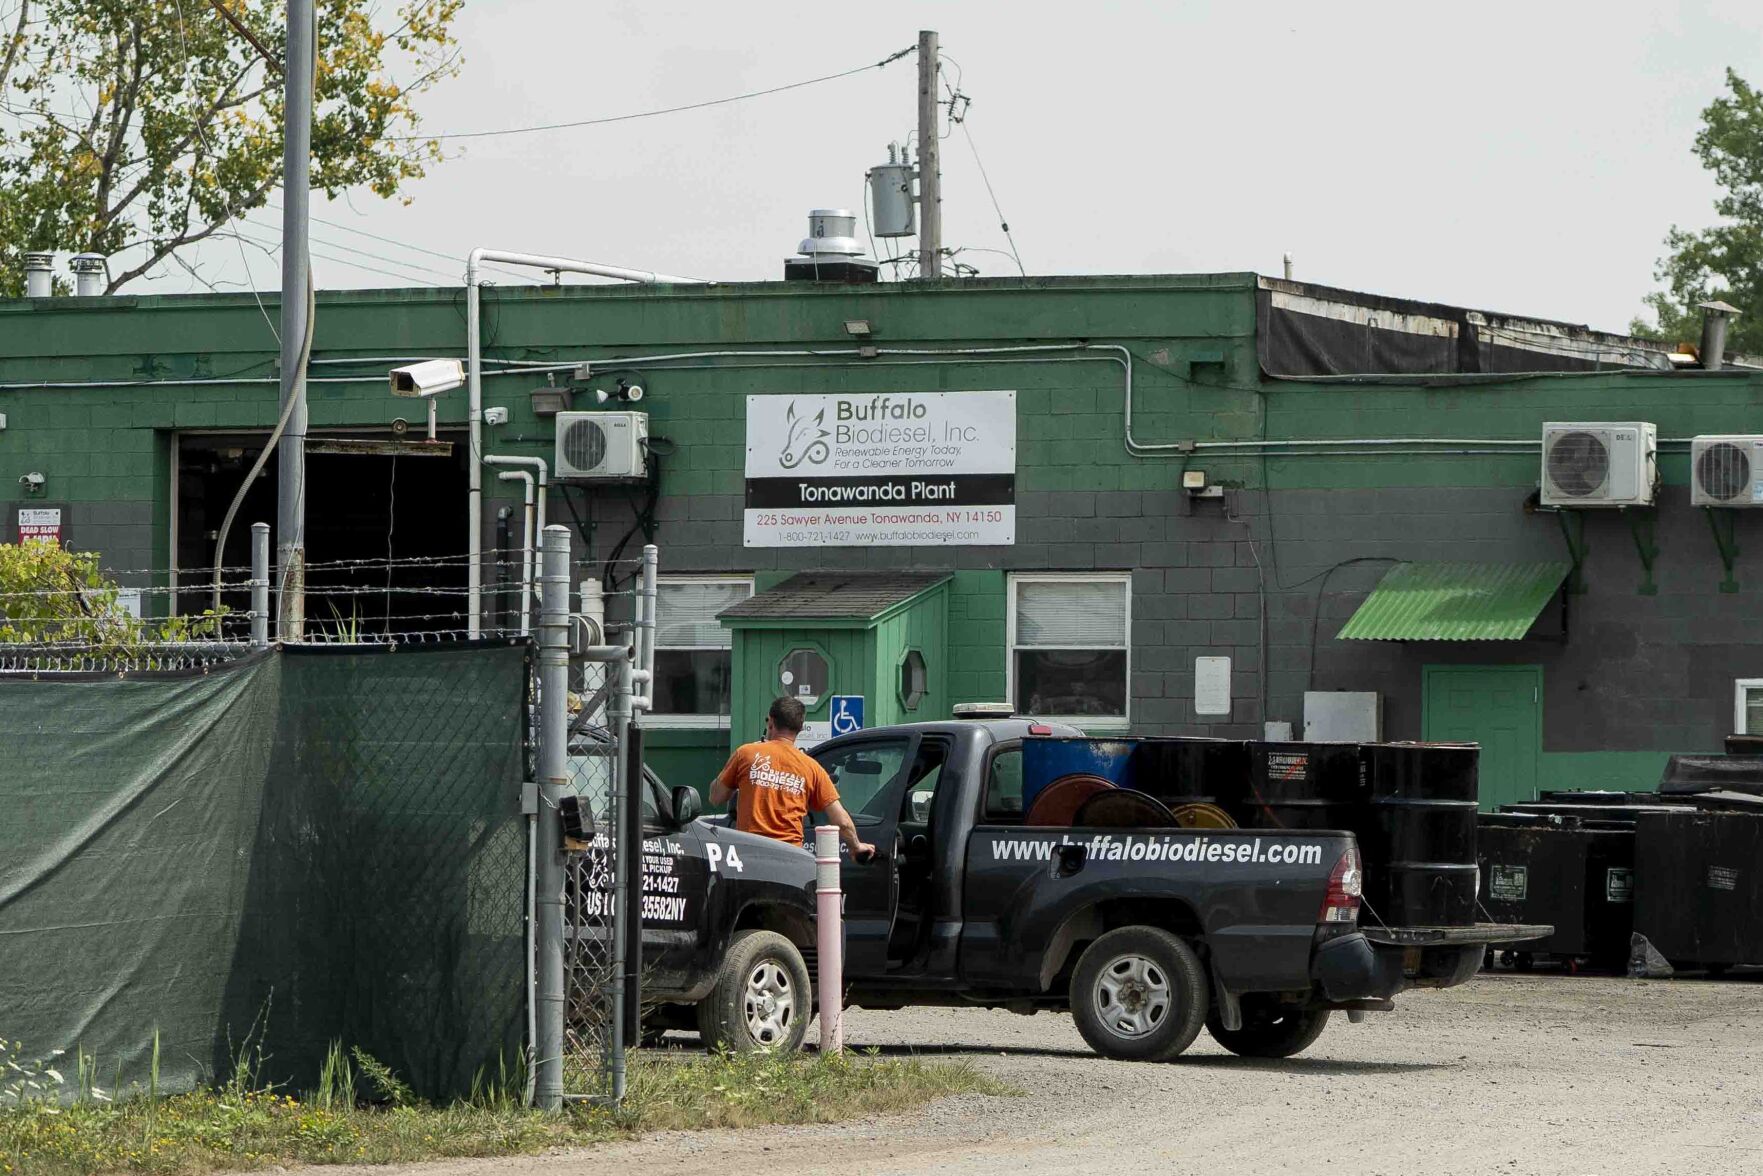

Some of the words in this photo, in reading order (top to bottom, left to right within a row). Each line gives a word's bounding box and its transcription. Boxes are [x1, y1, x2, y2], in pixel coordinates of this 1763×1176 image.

[836, 397, 927, 421] Buffalo
[836, 421, 936, 444] Biodiesel,
[944, 419, 980, 442] Inc.
[835, 446, 891, 458] Renewable
[892, 446, 928, 459] Energy
[834, 459, 852, 469] For
[852, 460, 860, 469] a
[862, 458, 901, 469] Cleaner
[904, 457, 955, 468] Tomorrow
[798, 482, 906, 502] Tonawanda
[911, 481, 956, 500] Plant
[756, 514, 778, 526] 225
[780, 513, 821, 527] Sawyer
[823, 513, 868, 525] Avenue
[870, 512, 943, 524] Tonawanda,
[946, 511, 962, 523] NY
[966, 511, 1002, 523] 14150
[20, 526, 39, 534] DEAD
[39, 526, 59, 534] SLOW
[778, 531, 851, 542] 1-800-721-1427
[855, 529, 979, 542] www.buffalobiodiesel.com
[749, 770, 806, 791] BIODIESEL
[666, 838, 685, 855] Inc.
[991, 835, 1322, 864] wwwffalobiodiesel.com
[645, 855, 659, 864] YOUR
[659, 856, 674, 866] USED
[649, 865, 673, 874] PICKUP
